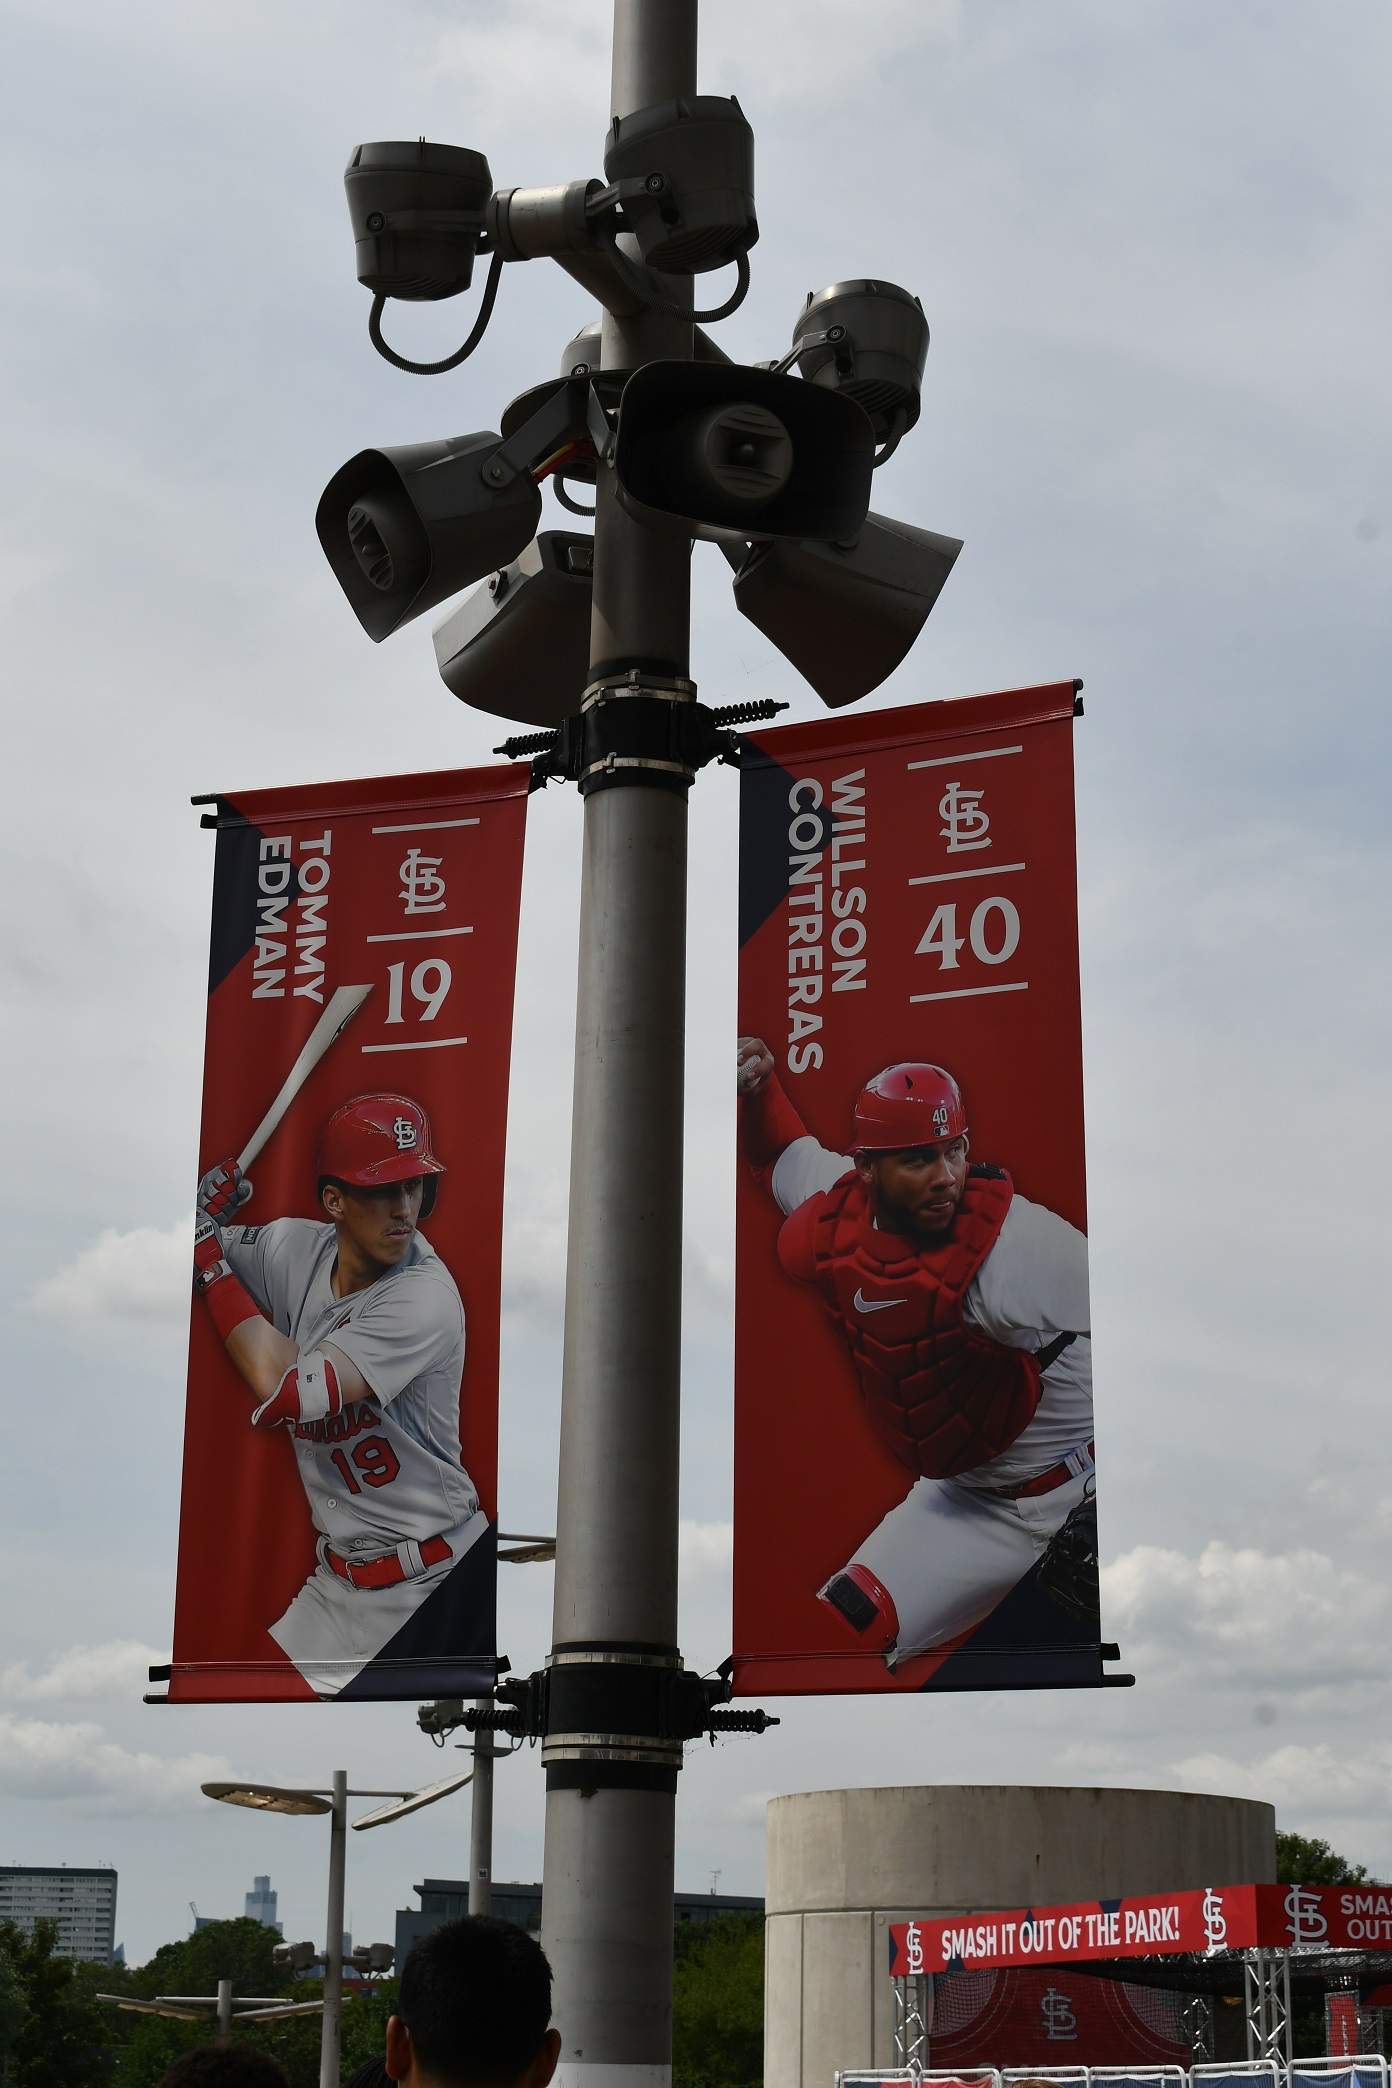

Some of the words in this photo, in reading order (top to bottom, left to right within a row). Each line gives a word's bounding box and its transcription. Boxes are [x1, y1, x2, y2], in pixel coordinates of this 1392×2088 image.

[831, 768, 866, 992] WILLSON
[252, 836, 292, 999] EDMAN
[293, 830, 332, 1004] TOMMY
[788, 777, 824, 1074] CONTRERAS
[914, 896, 1021, 971] 40
[384, 958, 452, 1024] 19
[932, 1107, 948, 1125] 40
[331, 1434, 401, 1494] 19
[942, 1924, 997, 1960] SMASH
[1001, 1923, 1016, 1955] IT
[1019, 1919, 1055, 1954] OUT
[1058, 1915, 1083, 1950] OF
[1085, 1912, 1121, 1947] THE
[1124, 1906, 1180, 1944] PARK!
[1340, 1894, 1392, 1916] SMA
[1347, 1919, 1392, 1940] OUT
